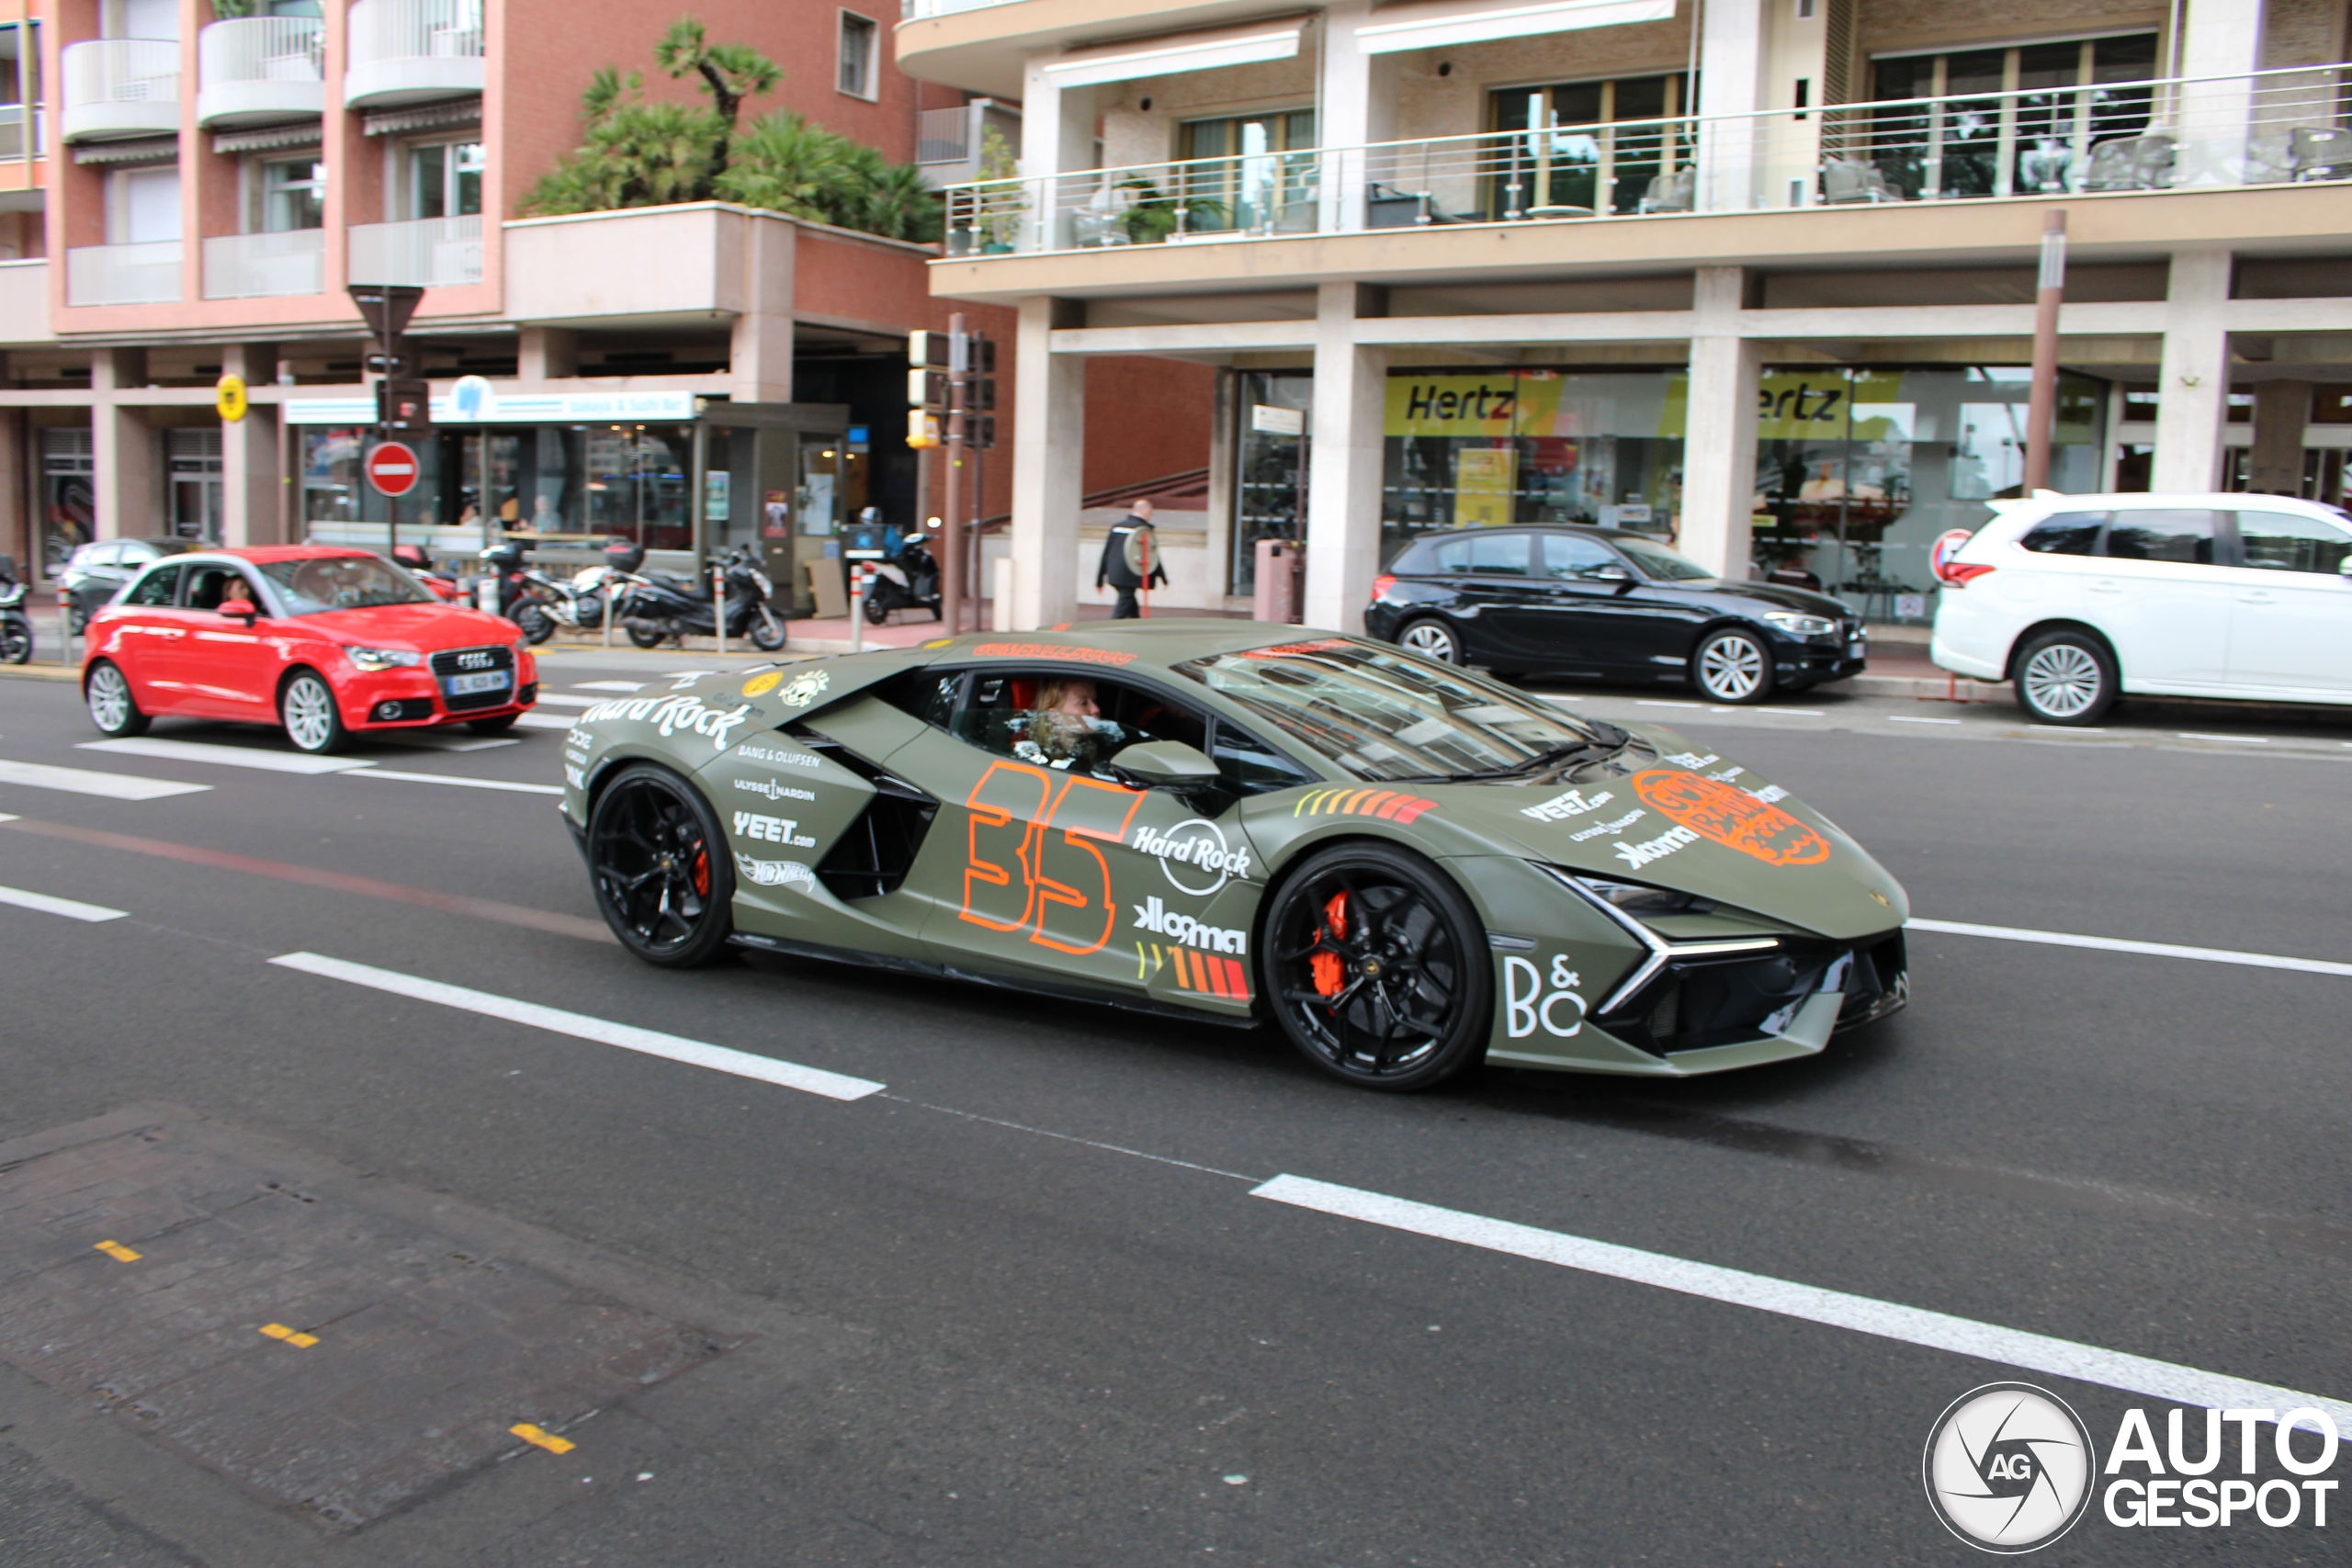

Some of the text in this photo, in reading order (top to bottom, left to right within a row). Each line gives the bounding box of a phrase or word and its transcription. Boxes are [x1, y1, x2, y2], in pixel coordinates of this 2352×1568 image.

[1407, 385, 1515, 420] Hertz
[1758, 382, 1842, 421] ertz
[650, 695, 752, 750] Rock
[738, 745, 821, 768] BANG & OLUFSEN
[733, 778, 816, 802] ULYSSE NARDIN
[733, 810, 817, 848] YEET.com
[957, 760, 1148, 955] 35
[1132, 826, 1251, 879] Hard Rock
